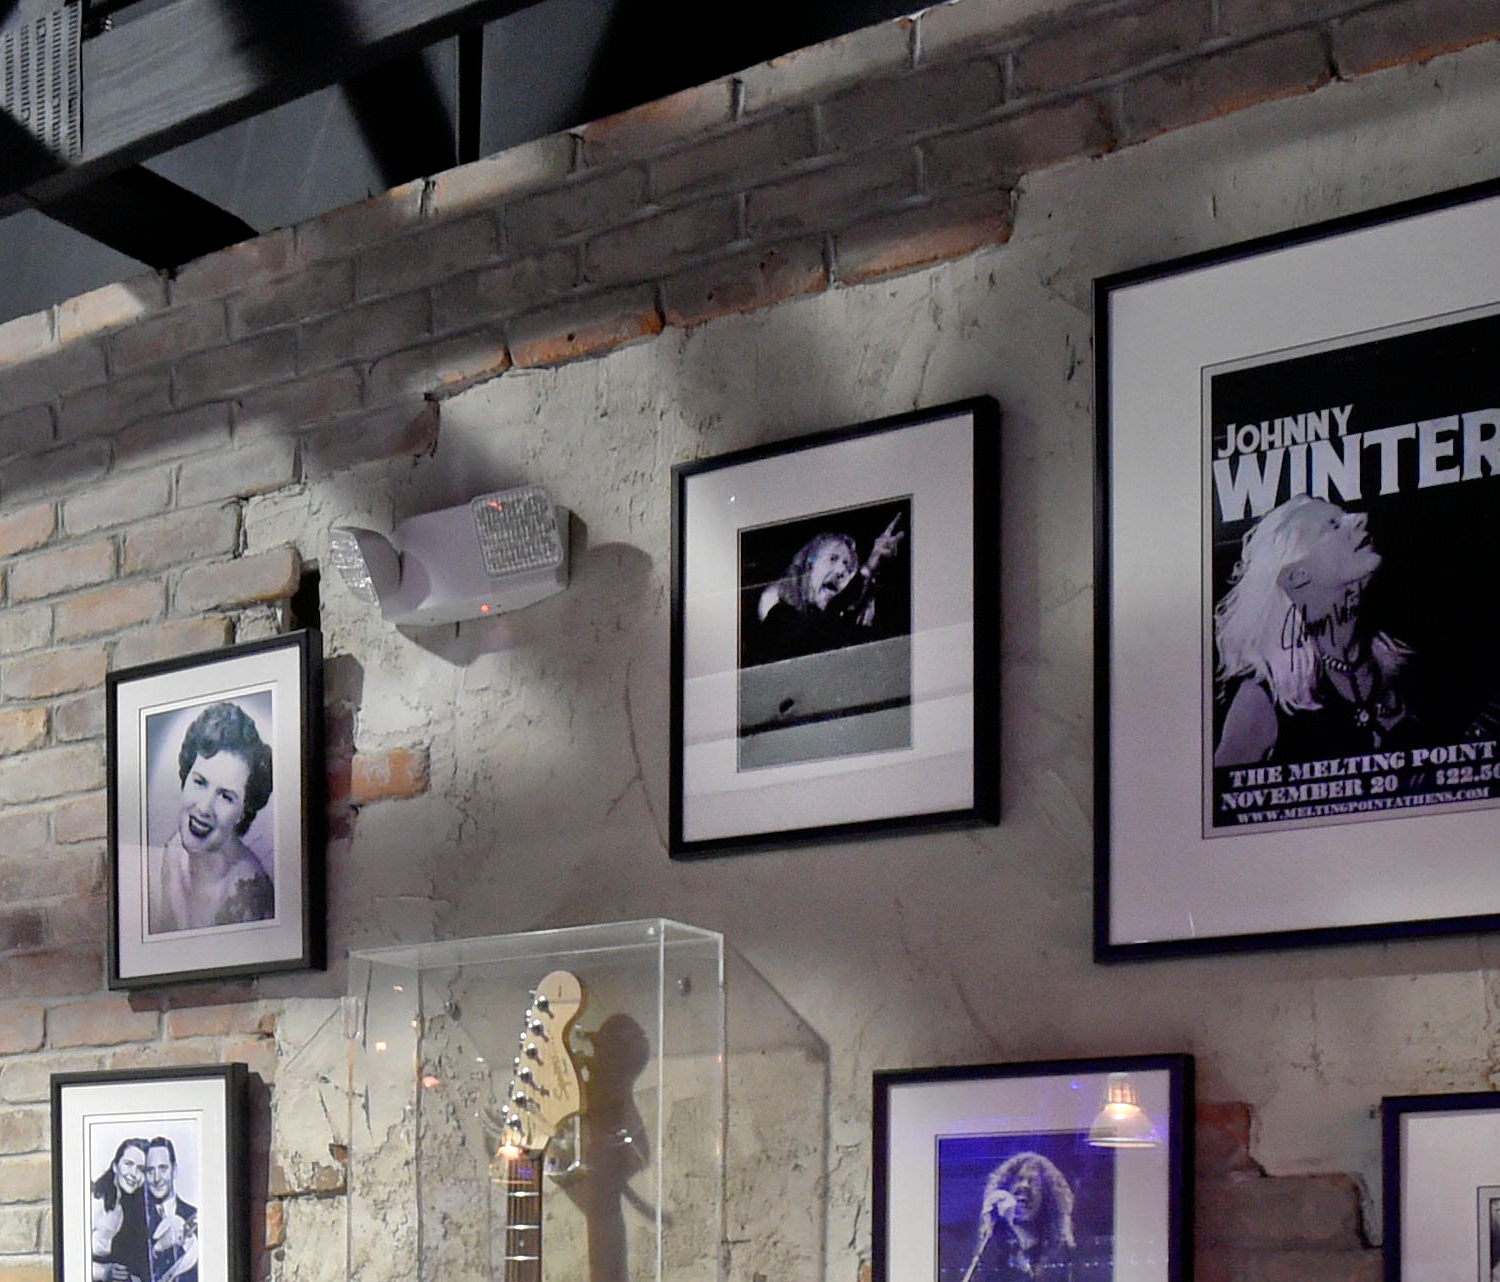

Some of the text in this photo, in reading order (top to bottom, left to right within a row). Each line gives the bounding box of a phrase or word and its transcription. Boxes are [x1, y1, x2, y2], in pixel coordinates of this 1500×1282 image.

[1217, 404, 1354, 458] JOHNNY
[1230, 741, 1497, 788] THE MELTING POINT
[1221, 778, 1363, 810] NOVEMBER
[1370, 774, 1398, 793] 20
[1237, 787, 1490, 824] WWW.MELTINGPOINTATHENS.COM
